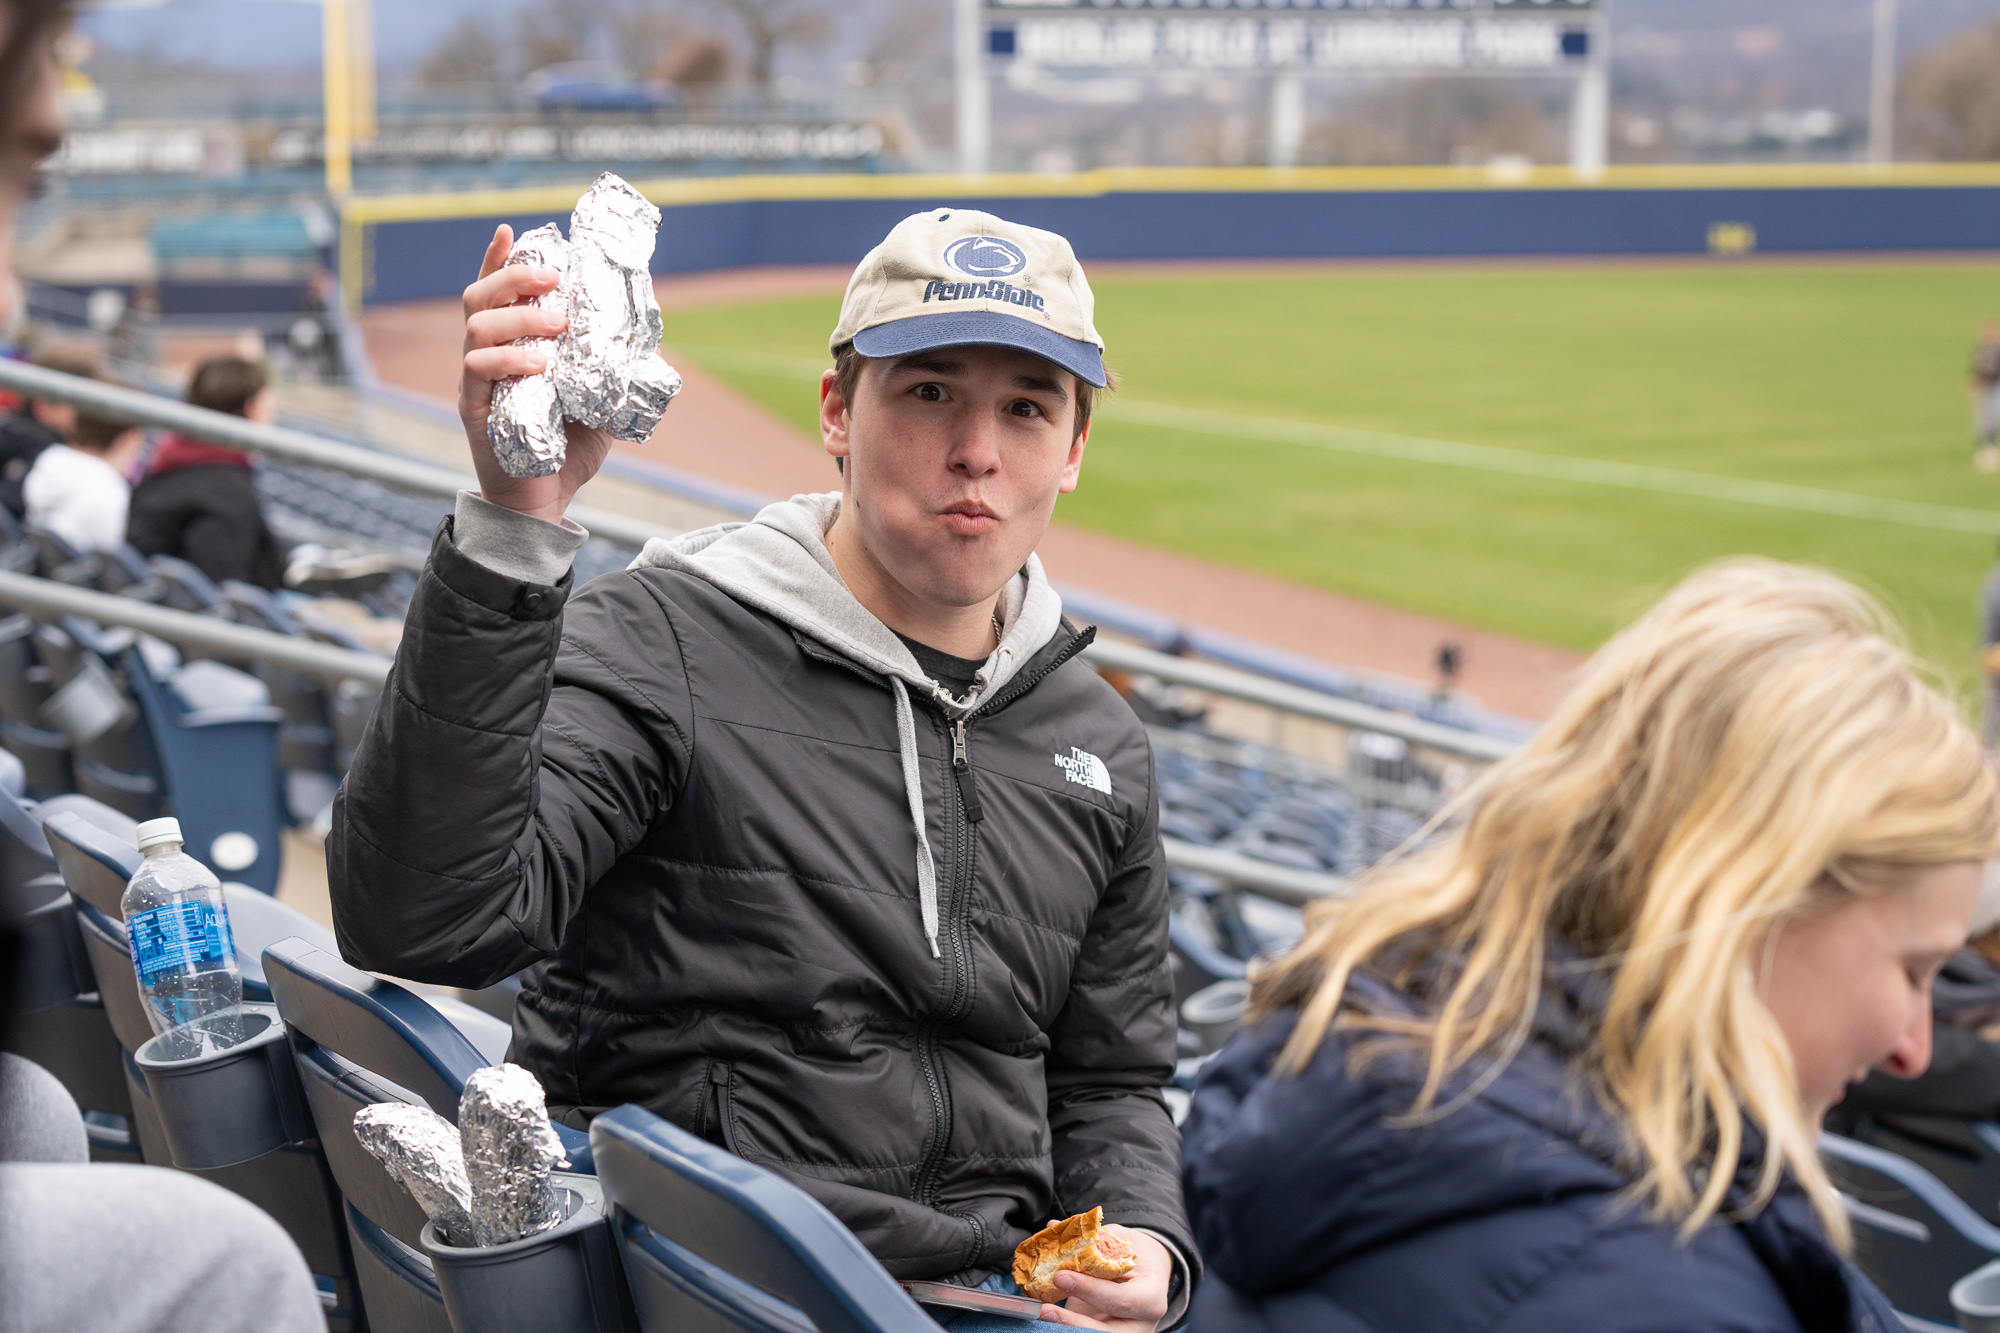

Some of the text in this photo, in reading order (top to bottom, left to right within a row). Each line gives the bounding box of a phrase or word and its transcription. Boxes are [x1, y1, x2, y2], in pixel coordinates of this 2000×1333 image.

[1054, 753, 1093, 777] NORTH
[1070, 746, 1092, 764] THE
[1065, 769, 1095, 789] FACE
